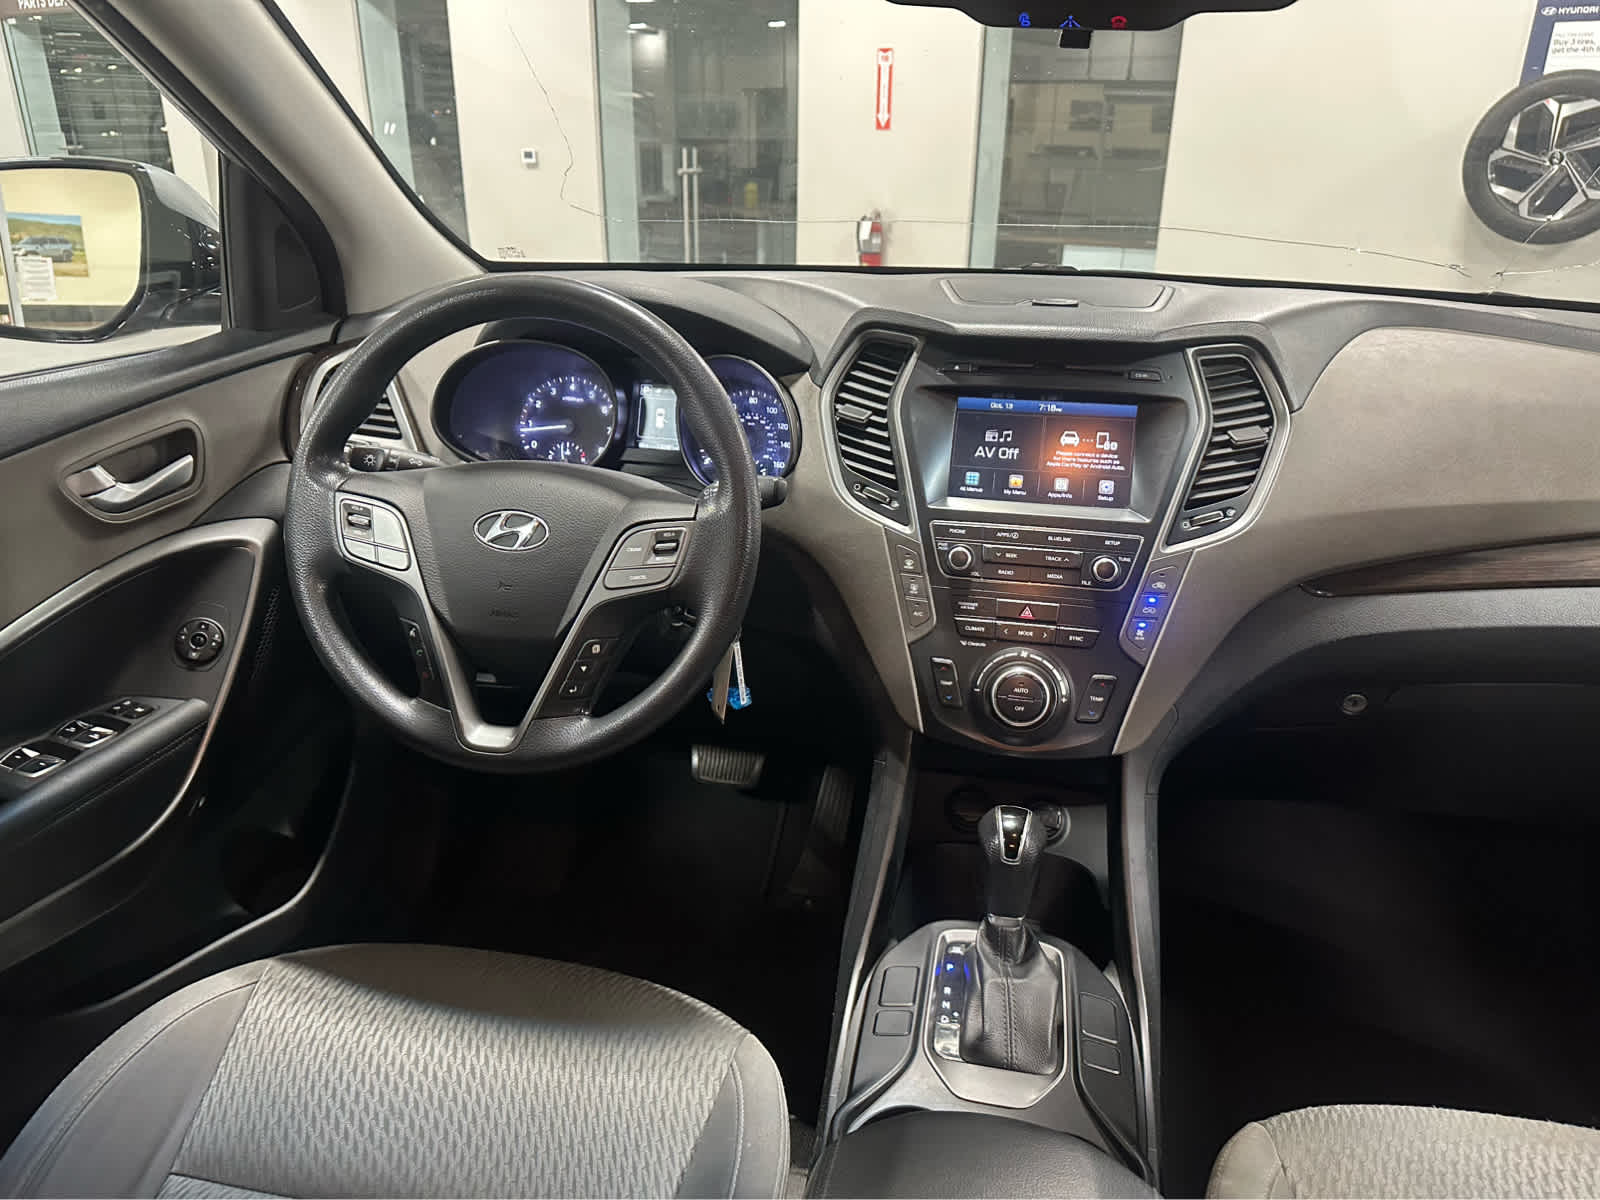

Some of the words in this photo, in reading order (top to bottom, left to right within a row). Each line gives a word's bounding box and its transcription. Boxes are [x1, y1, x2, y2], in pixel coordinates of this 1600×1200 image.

[1558, 5, 1600, 15] HYUNDAI
[535, 400, 541, 408] 2
[601, 406, 608, 415] 6
[766, 406, 778, 414] 100
[531, 441, 538, 449] 0
[974, 446, 996, 459] AV
[998, 447, 1020, 460] Off
[946, 963, 954, 971] P
[943, 986, 952, 995] R
[942, 1000, 951, 1009] N
[941, 1015, 950, 1023] D
